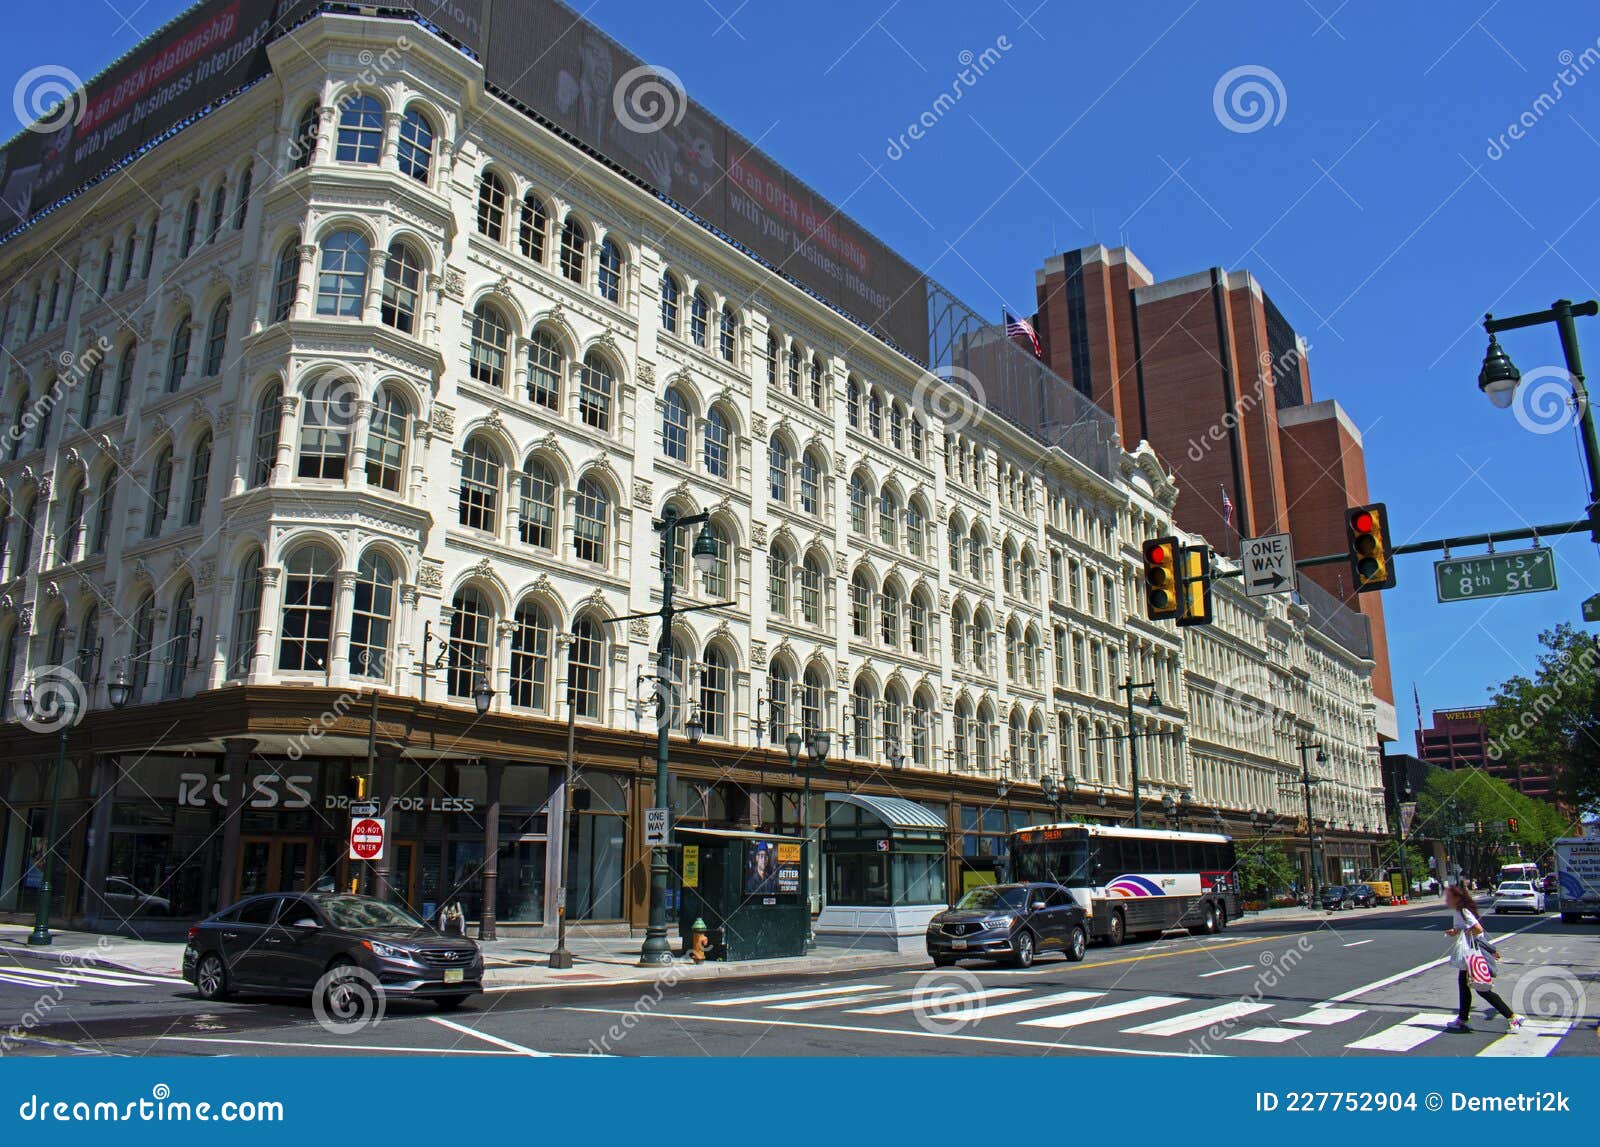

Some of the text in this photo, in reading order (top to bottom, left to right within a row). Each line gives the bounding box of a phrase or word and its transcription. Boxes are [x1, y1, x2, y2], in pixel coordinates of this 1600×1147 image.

[95, 98, 110, 121] an
[113, 68, 148, 107] OPEN
[150, 13, 234, 80] relationship
[74, 130, 101, 164] with
[102, 114, 131, 150] your
[132, 73, 193, 125] business
[747, 172, 762, 194] an
[766, 182, 798, 220] OPEN
[801, 213, 867, 273] relationship
[729, 192, 759, 225] with
[762, 214, 791, 244] your
[793, 231, 843, 281] business
[1251, 540, 1283, 556] ONE
[1251, 555, 1284, 571] WAY
[1459, 571, 1533, 595] 8th St
[1445, 711, 1481, 721] WELLS
[431, 798, 475, 812] LESS
[648, 812, 665, 821] ONE
[648, 822, 665, 831] WAY
